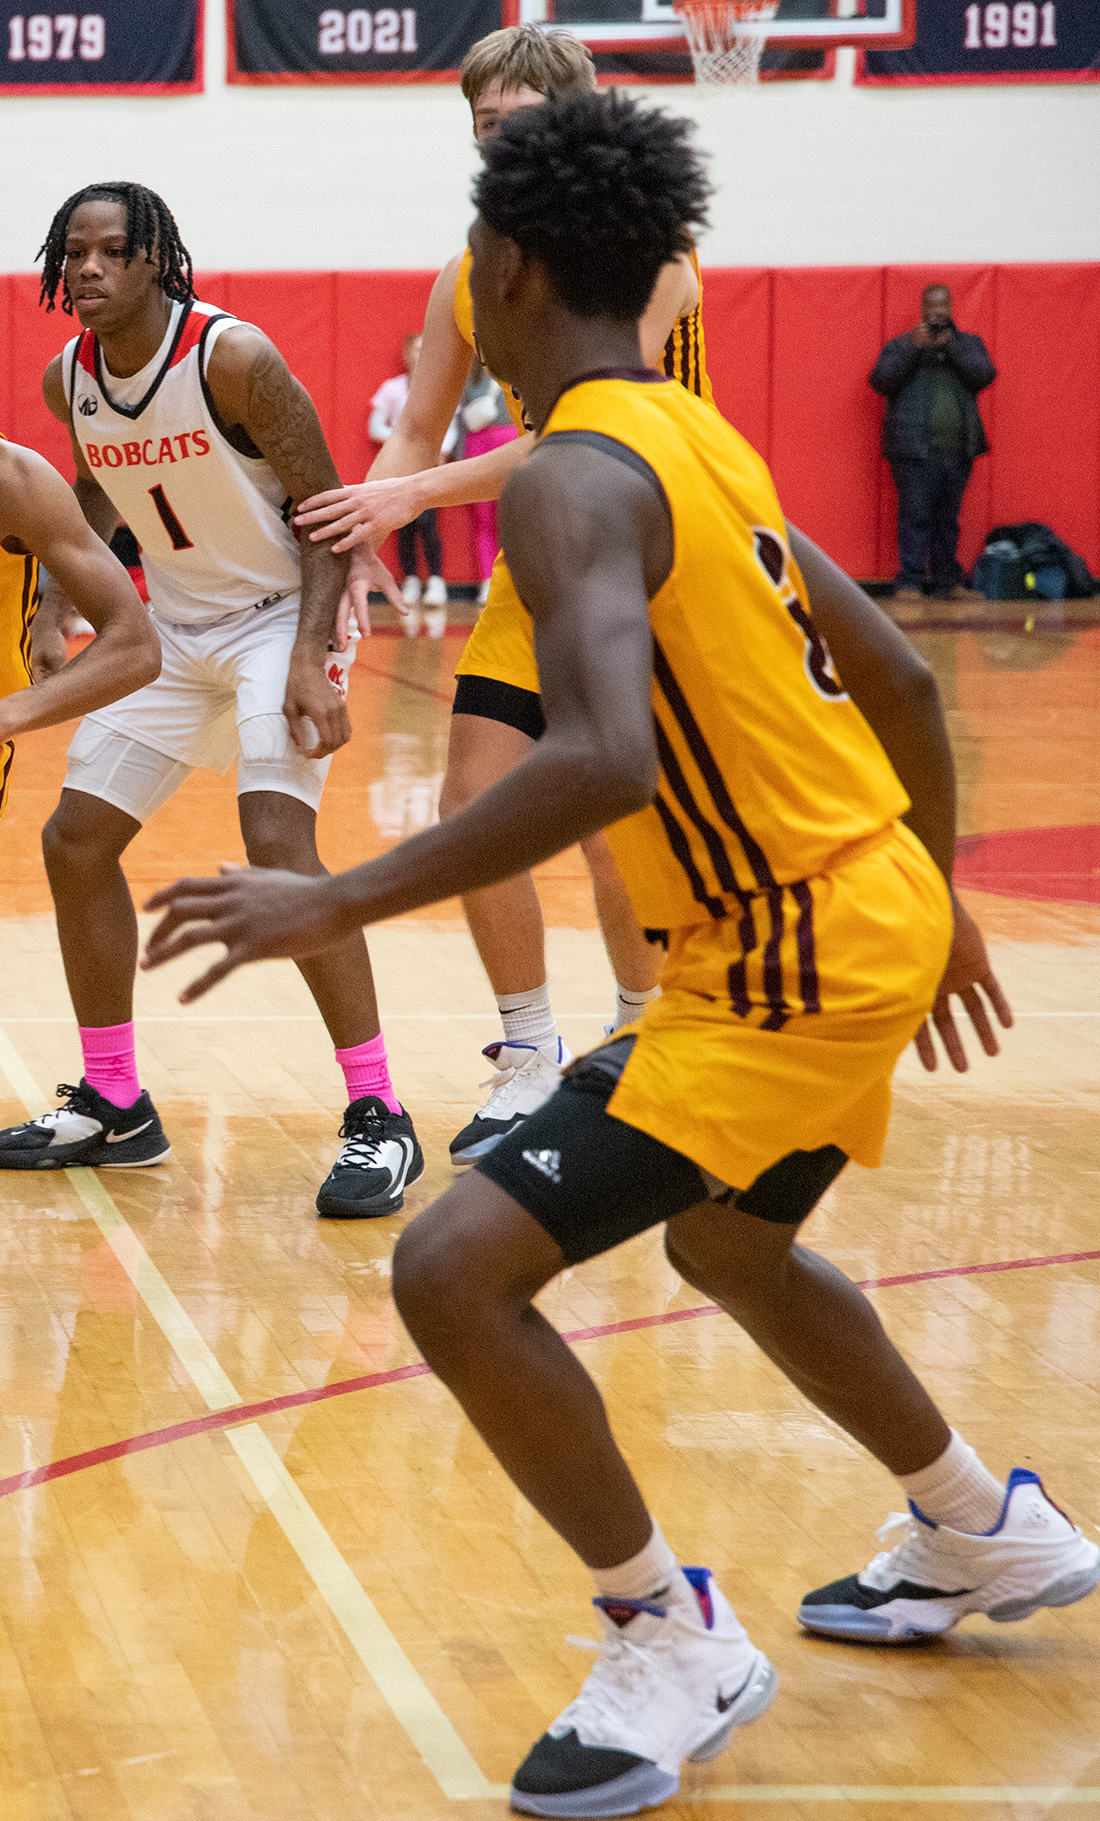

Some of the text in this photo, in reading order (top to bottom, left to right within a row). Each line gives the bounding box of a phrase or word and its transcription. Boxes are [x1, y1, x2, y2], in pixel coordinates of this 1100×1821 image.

[8, 15, 106, 61] 1979
[318, 10, 418, 54] 2021
[964, 2, 1058, 48] 1991
[85, 429, 211, 468] BOBCATS
[148, 483, 195, 551] 1
